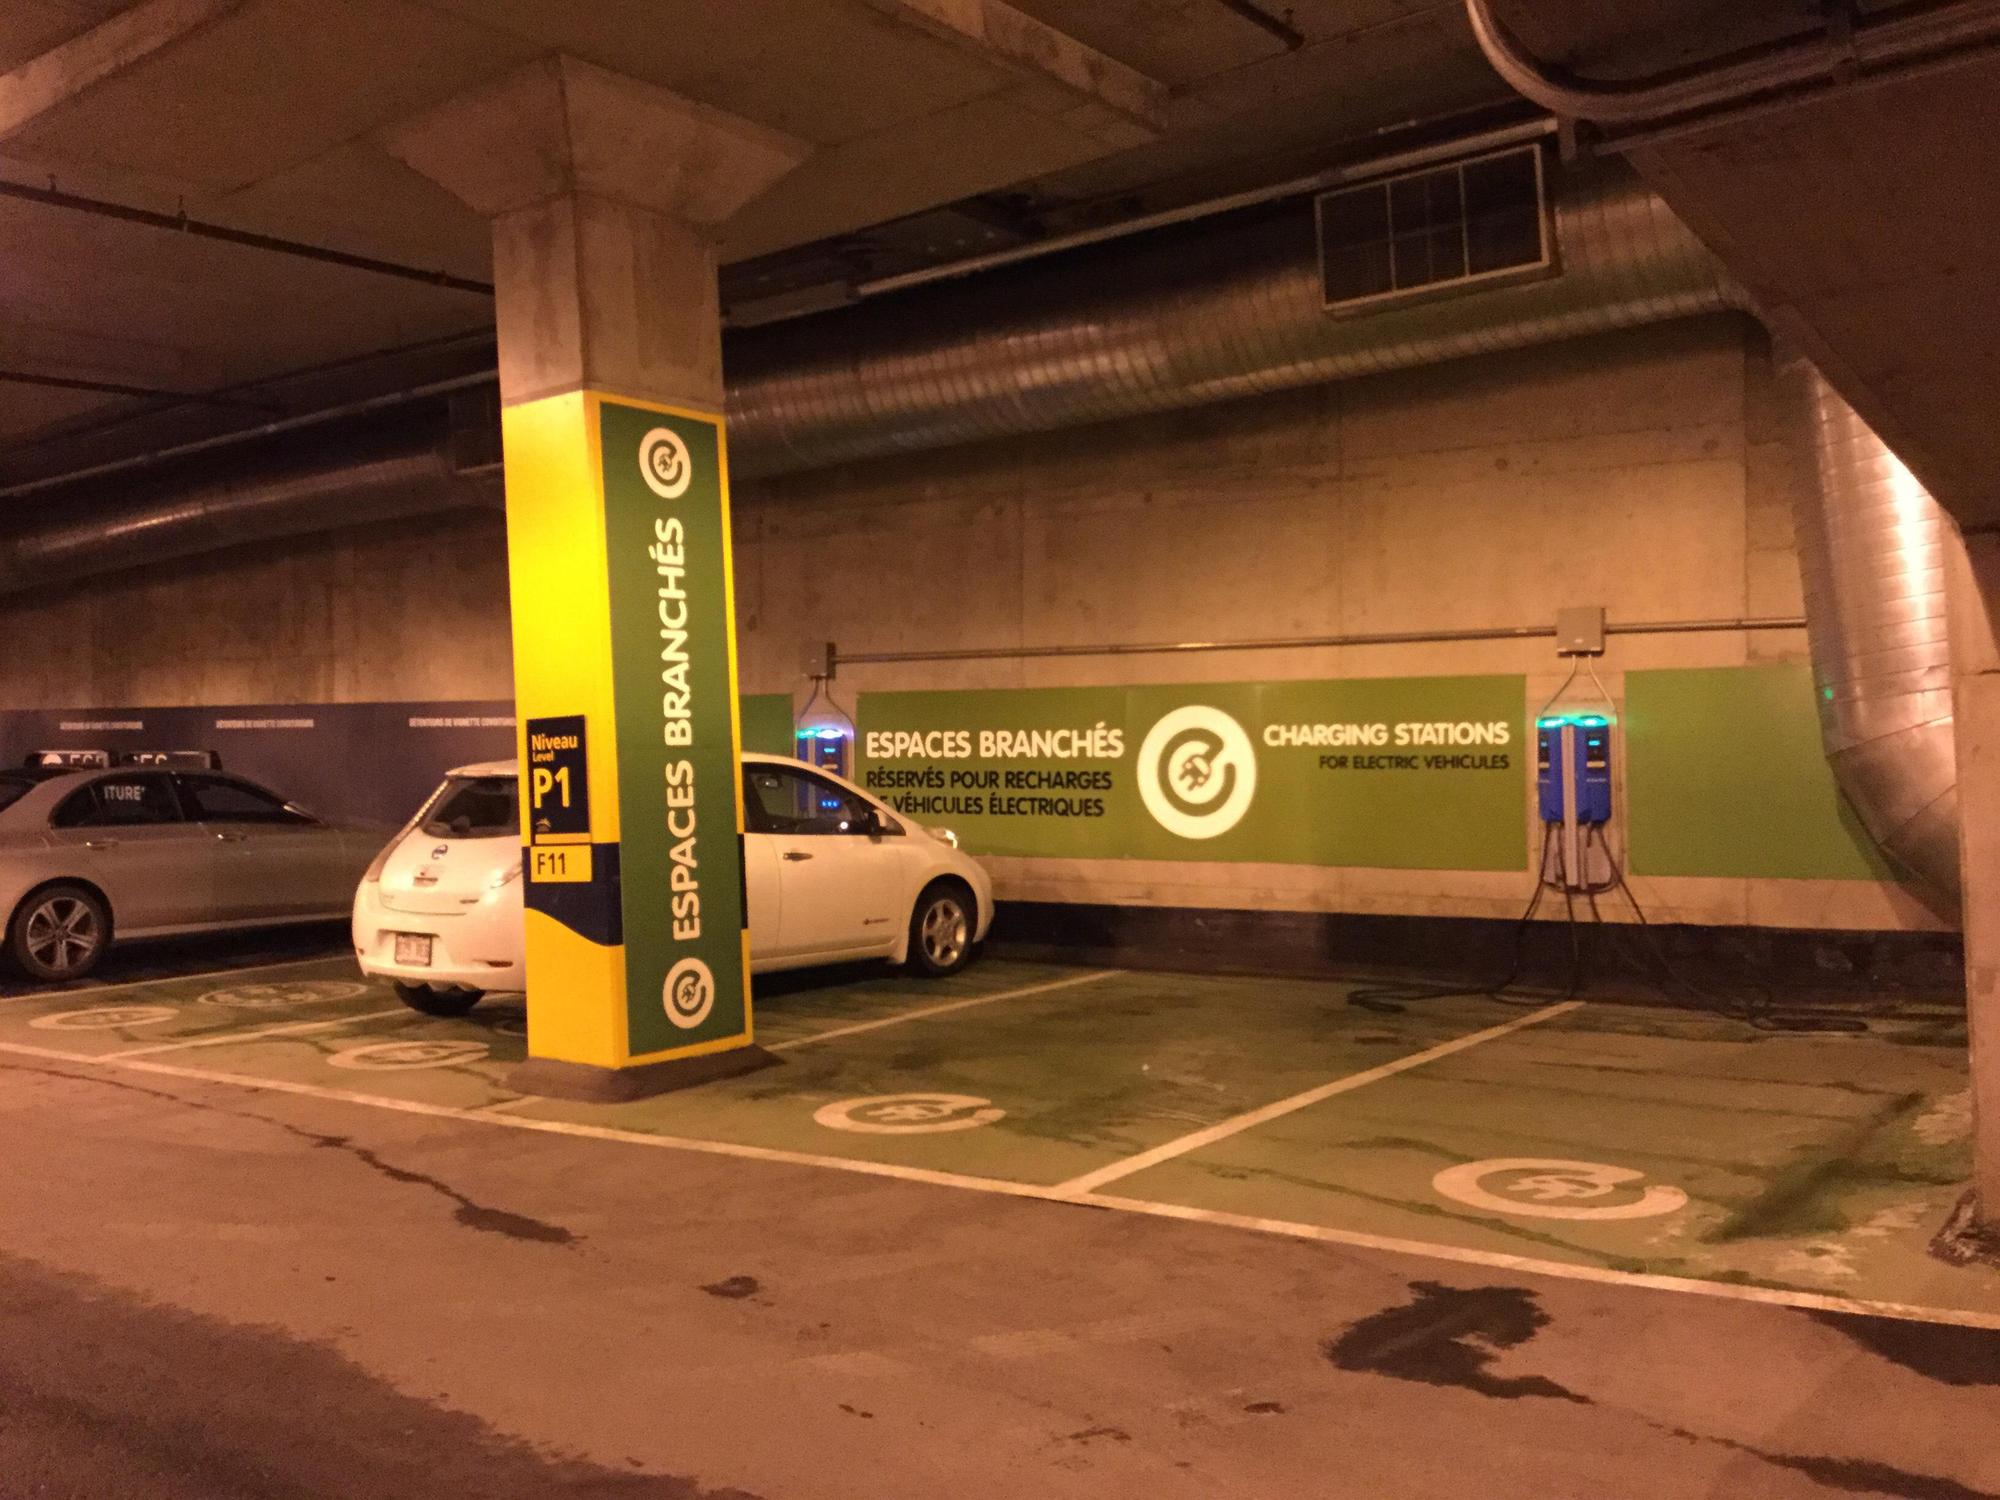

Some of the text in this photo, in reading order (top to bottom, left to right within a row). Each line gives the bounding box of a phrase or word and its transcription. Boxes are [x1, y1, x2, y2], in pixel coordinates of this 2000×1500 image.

[648, 517, 701, 941] ESPACES BRANCHÉS
[866, 721, 1125, 758] ESPACES BRANCHÉS
[1263, 722, 1510, 747] CHARGING STATIONS
[531, 734, 578, 750] Niveau
[532, 750, 555, 762] Level
[1319, 755, 1510, 770] FOR ELECTRIC VEHICULES
[533, 766, 570, 809] P1
[866, 766, 1112, 790] RÉSERVÉS POUR RECHARGES
[893, 791, 1105, 817] VÉHICULES ÉLECTRIQUES
[537, 853, 567, 875] F11
